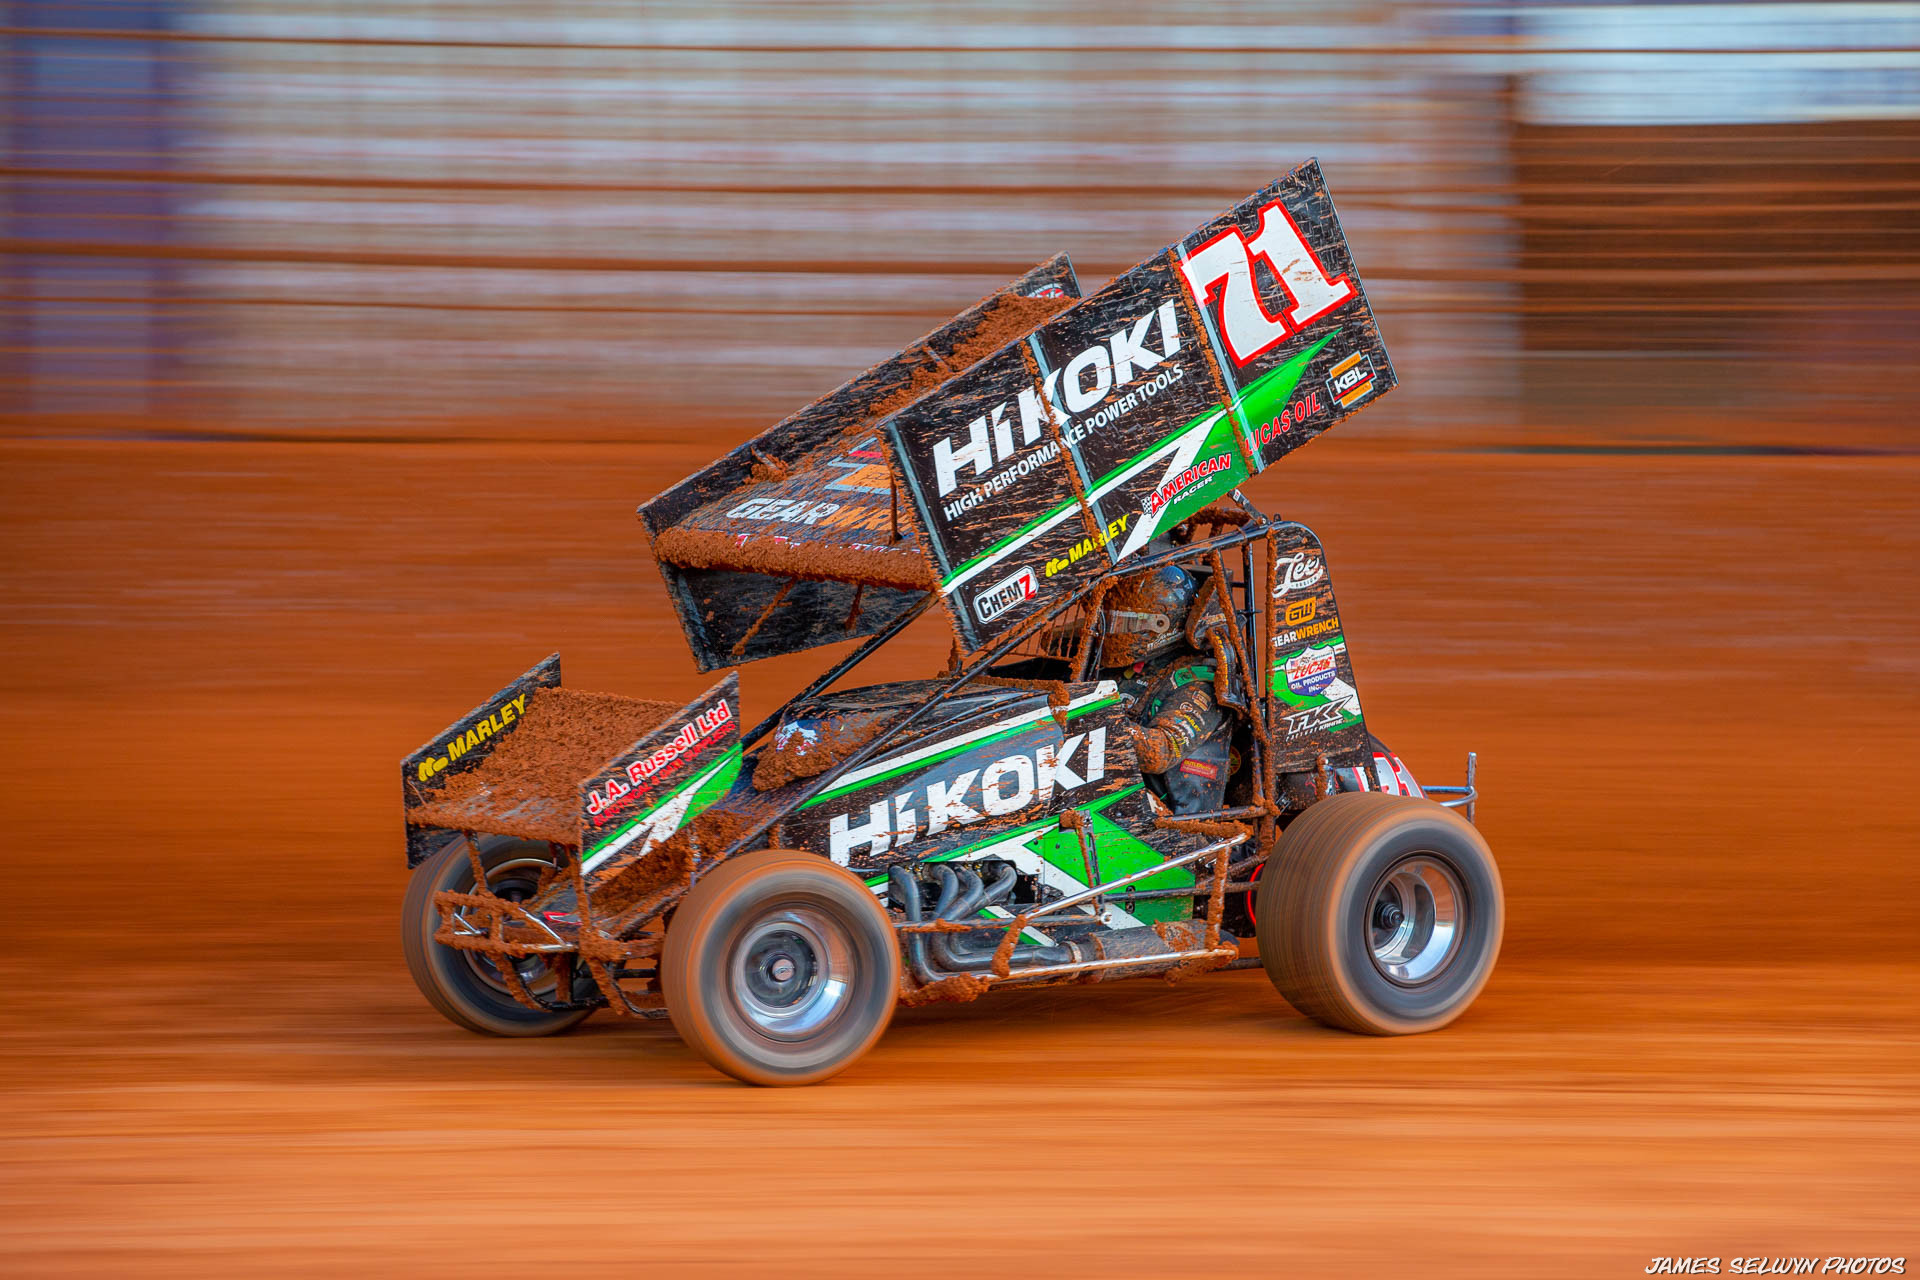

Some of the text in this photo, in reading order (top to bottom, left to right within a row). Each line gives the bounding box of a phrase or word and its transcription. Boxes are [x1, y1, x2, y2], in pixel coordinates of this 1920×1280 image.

[1180, 199, 1358, 368] 71
[1334, 367, 1368, 393] KBL
[943, 364, 1184, 521] HIGH PERFORMANCE POWER TOOLS
[1245, 410, 1291, 455] LUCAS
[1295, 392, 1320, 422] OIL
[1150, 453, 1232, 517] AMERICAN
[1173, 476, 1213, 504] RACER
[1068, 513, 1129, 563] MARLEY
[1293, 656, 1332, 680] LUCAS
[1303, 670, 1335, 686] PRODUCTS
[447, 693, 527, 762] MARLEY
[586, 698, 732, 815] J.A. Russell Ltd
